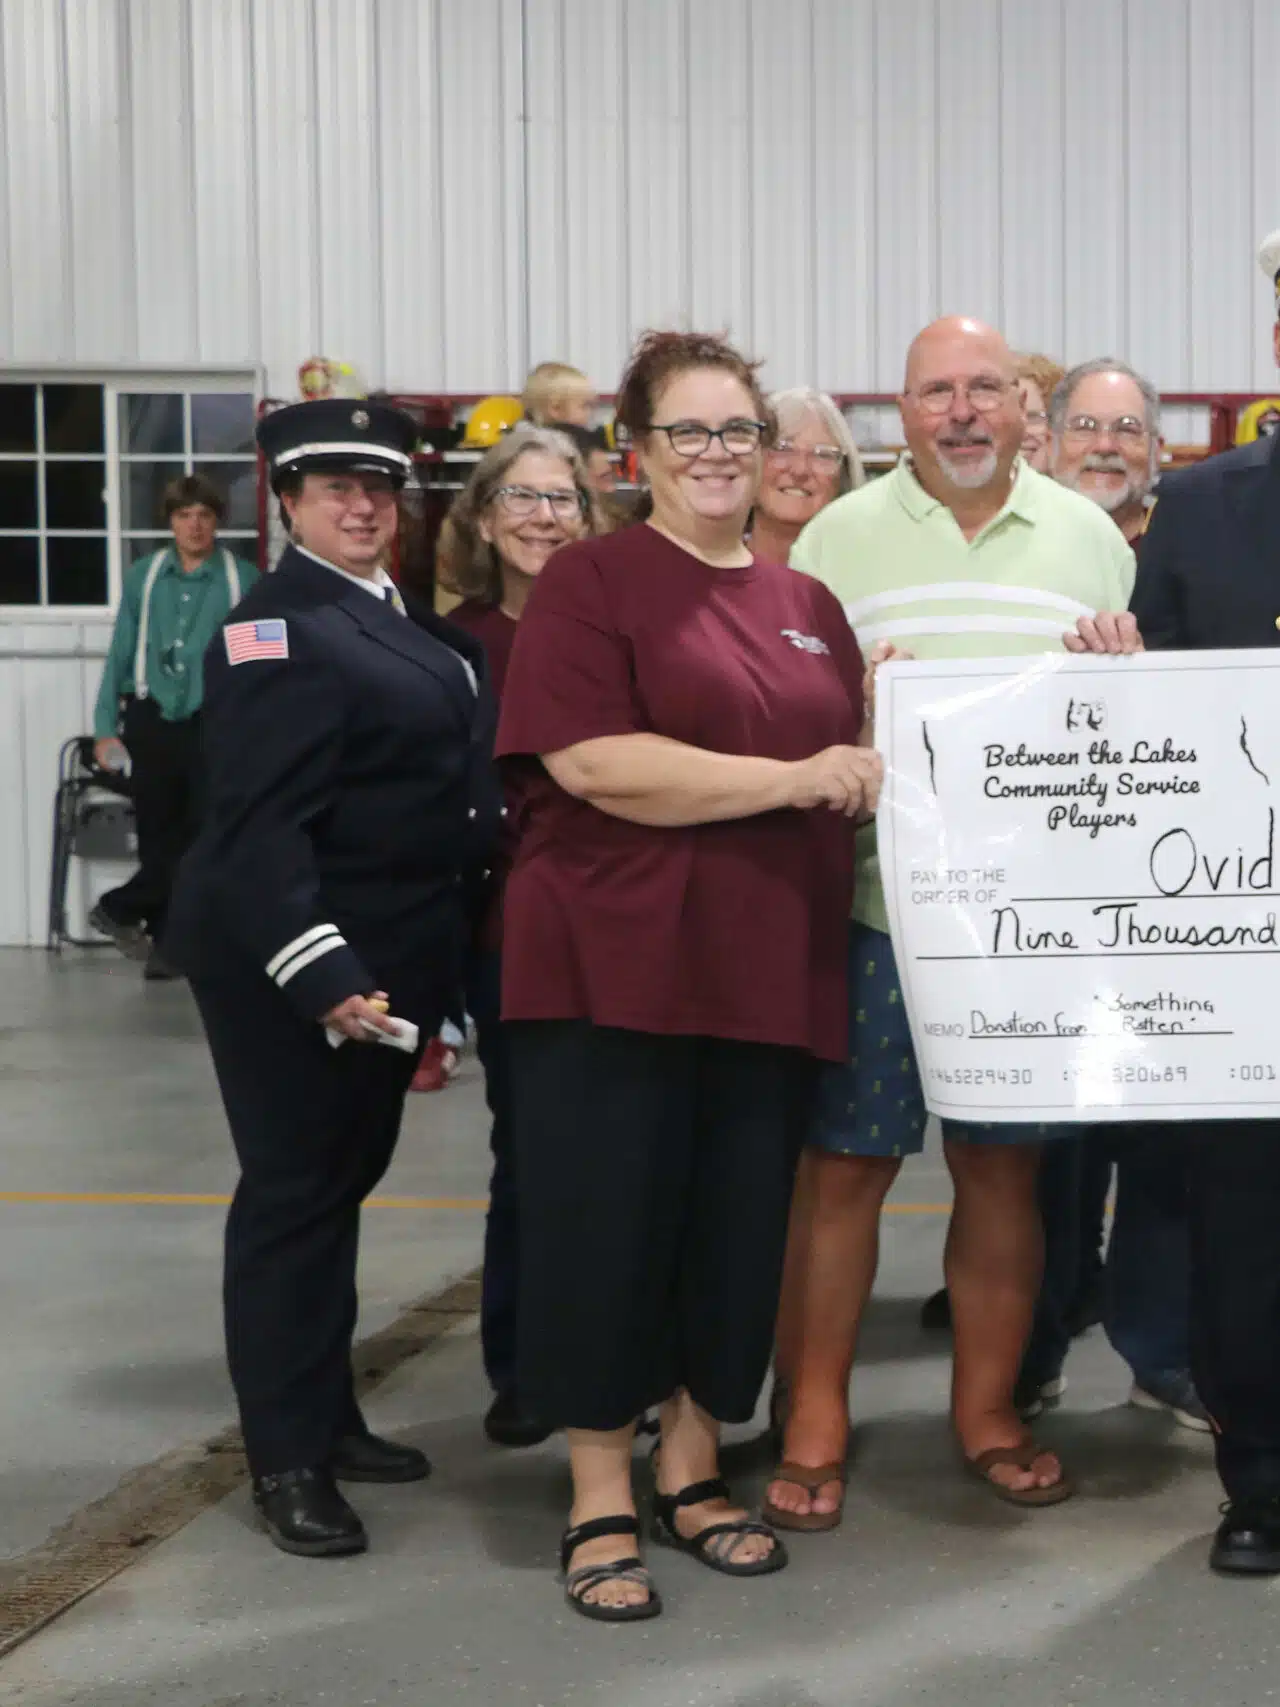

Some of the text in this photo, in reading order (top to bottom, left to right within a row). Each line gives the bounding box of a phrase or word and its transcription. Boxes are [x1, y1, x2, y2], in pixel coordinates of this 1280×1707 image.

[983, 737, 1197, 768] Between the Lakes
[984, 771, 1201, 808] Community Service
[1047, 802, 1137, 839] Players
[1150, 806, 1274, 897] Ovid
[946, 868, 968, 884] TO
[972, 867, 1006, 883] THE
[974, 888, 998, 904] OF
[991, 906, 1079, 953] Nine
[1092, 902, 1278, 948] Thousand
[924, 1023, 964, 1037] MEMO
[970, 1009, 1048, 1035] Donation
